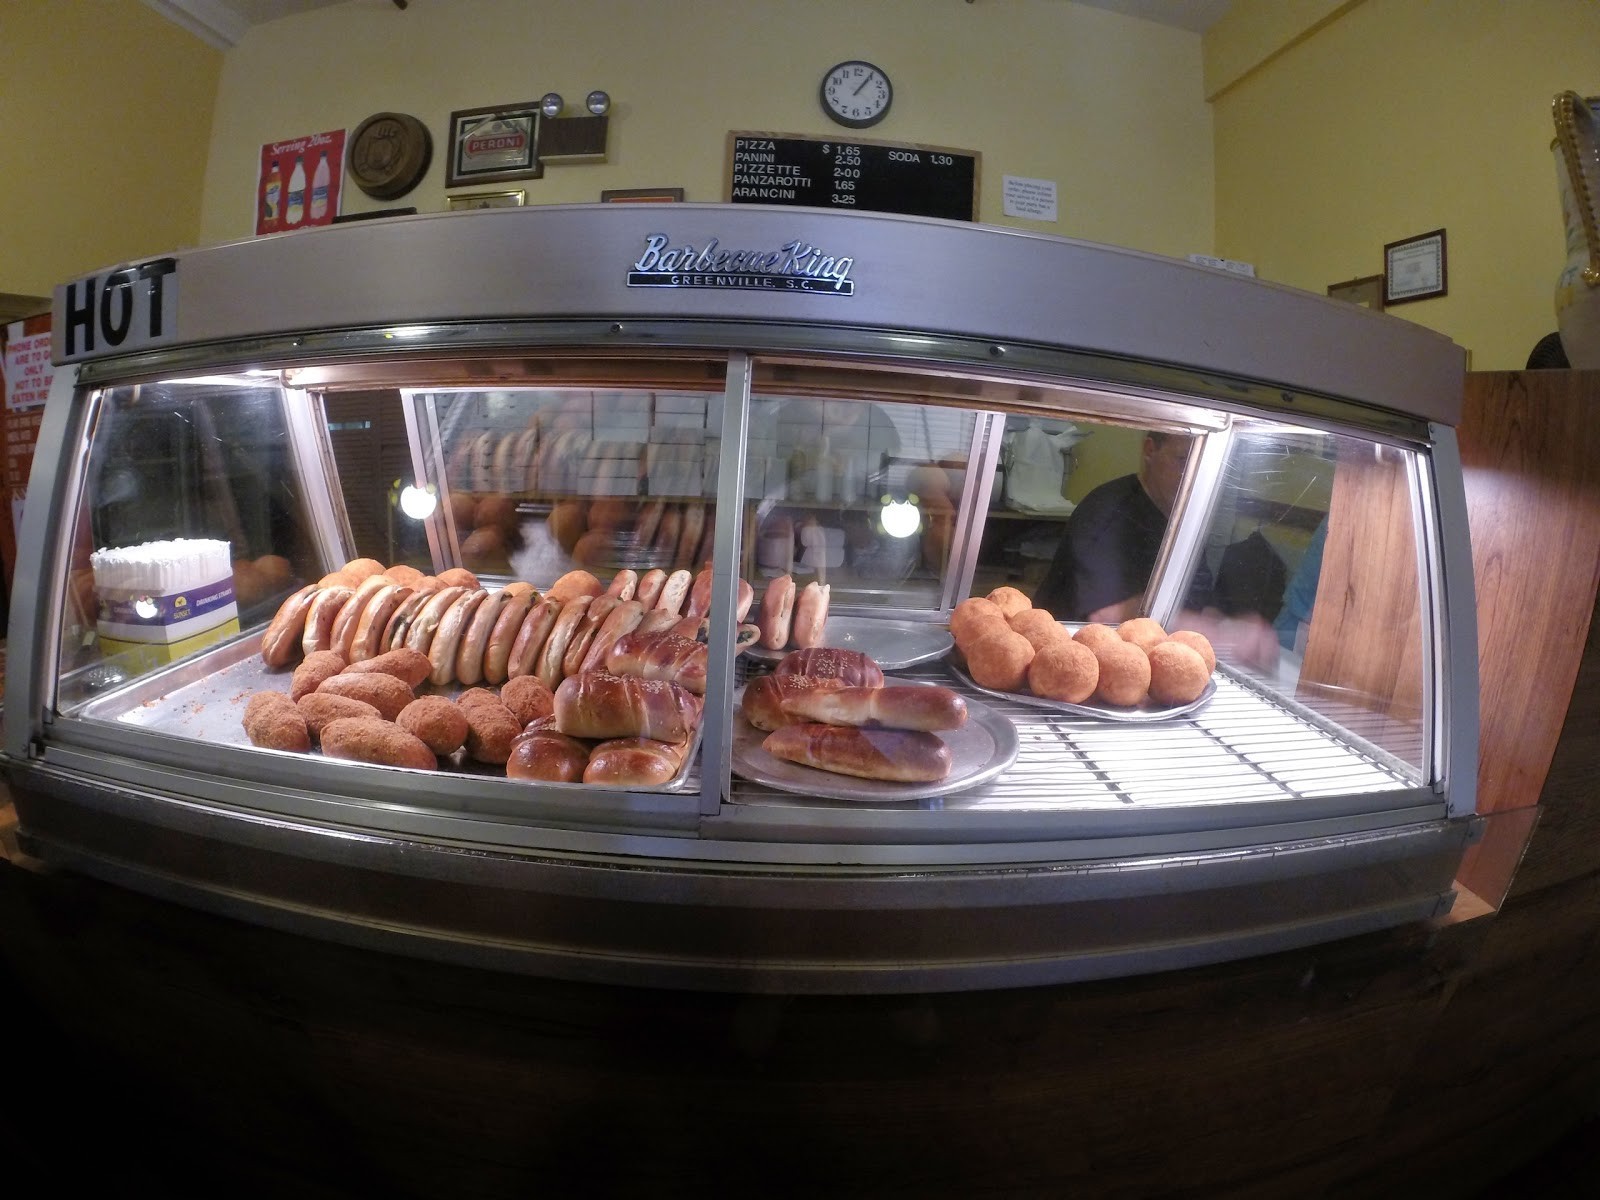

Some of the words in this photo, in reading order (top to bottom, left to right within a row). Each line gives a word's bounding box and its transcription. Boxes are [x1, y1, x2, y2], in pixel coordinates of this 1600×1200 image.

[842, 70, 849, 78] 11
[854, 68, 863, 77] 12
[271, 140, 306, 156] Serving
[472, 136, 522, 150] PERONI
[736, 140, 776, 150] PIZZA
[822, 144, 830, 154] $
[836, 145, 861, 156] 1.65
[735, 152, 775, 163] PANINI
[834, 155, 861, 166] 2.50
[888, 151, 921, 163] SODA
[930, 155, 953, 166] 1.30
[734, 163, 801, 176] PIZZETTE
[833, 167, 861, 178] 2.00
[734, 174, 811, 188] PANZAROTTI
[834, 180, 855, 190] 1.65
[732, 187, 796, 199] ARANCINI
[831, 193, 856, 204] 3.25
[634, 233, 780, 274] Barbecue
[779, 239, 854, 290] King
[786, 280, 814, 290] S.C.
[65, 257, 176, 357] HOT
[16, 353, 29, 365] ARE
[33, 351, 41, 360] TO
[24, 364, 44, 376] ONLY
[16, 380, 29, 390] NOT
[32, 377, 41, 388] TO
[12, 392, 35, 404] EATEN
[173, 609, 191, 620] SUNSET
